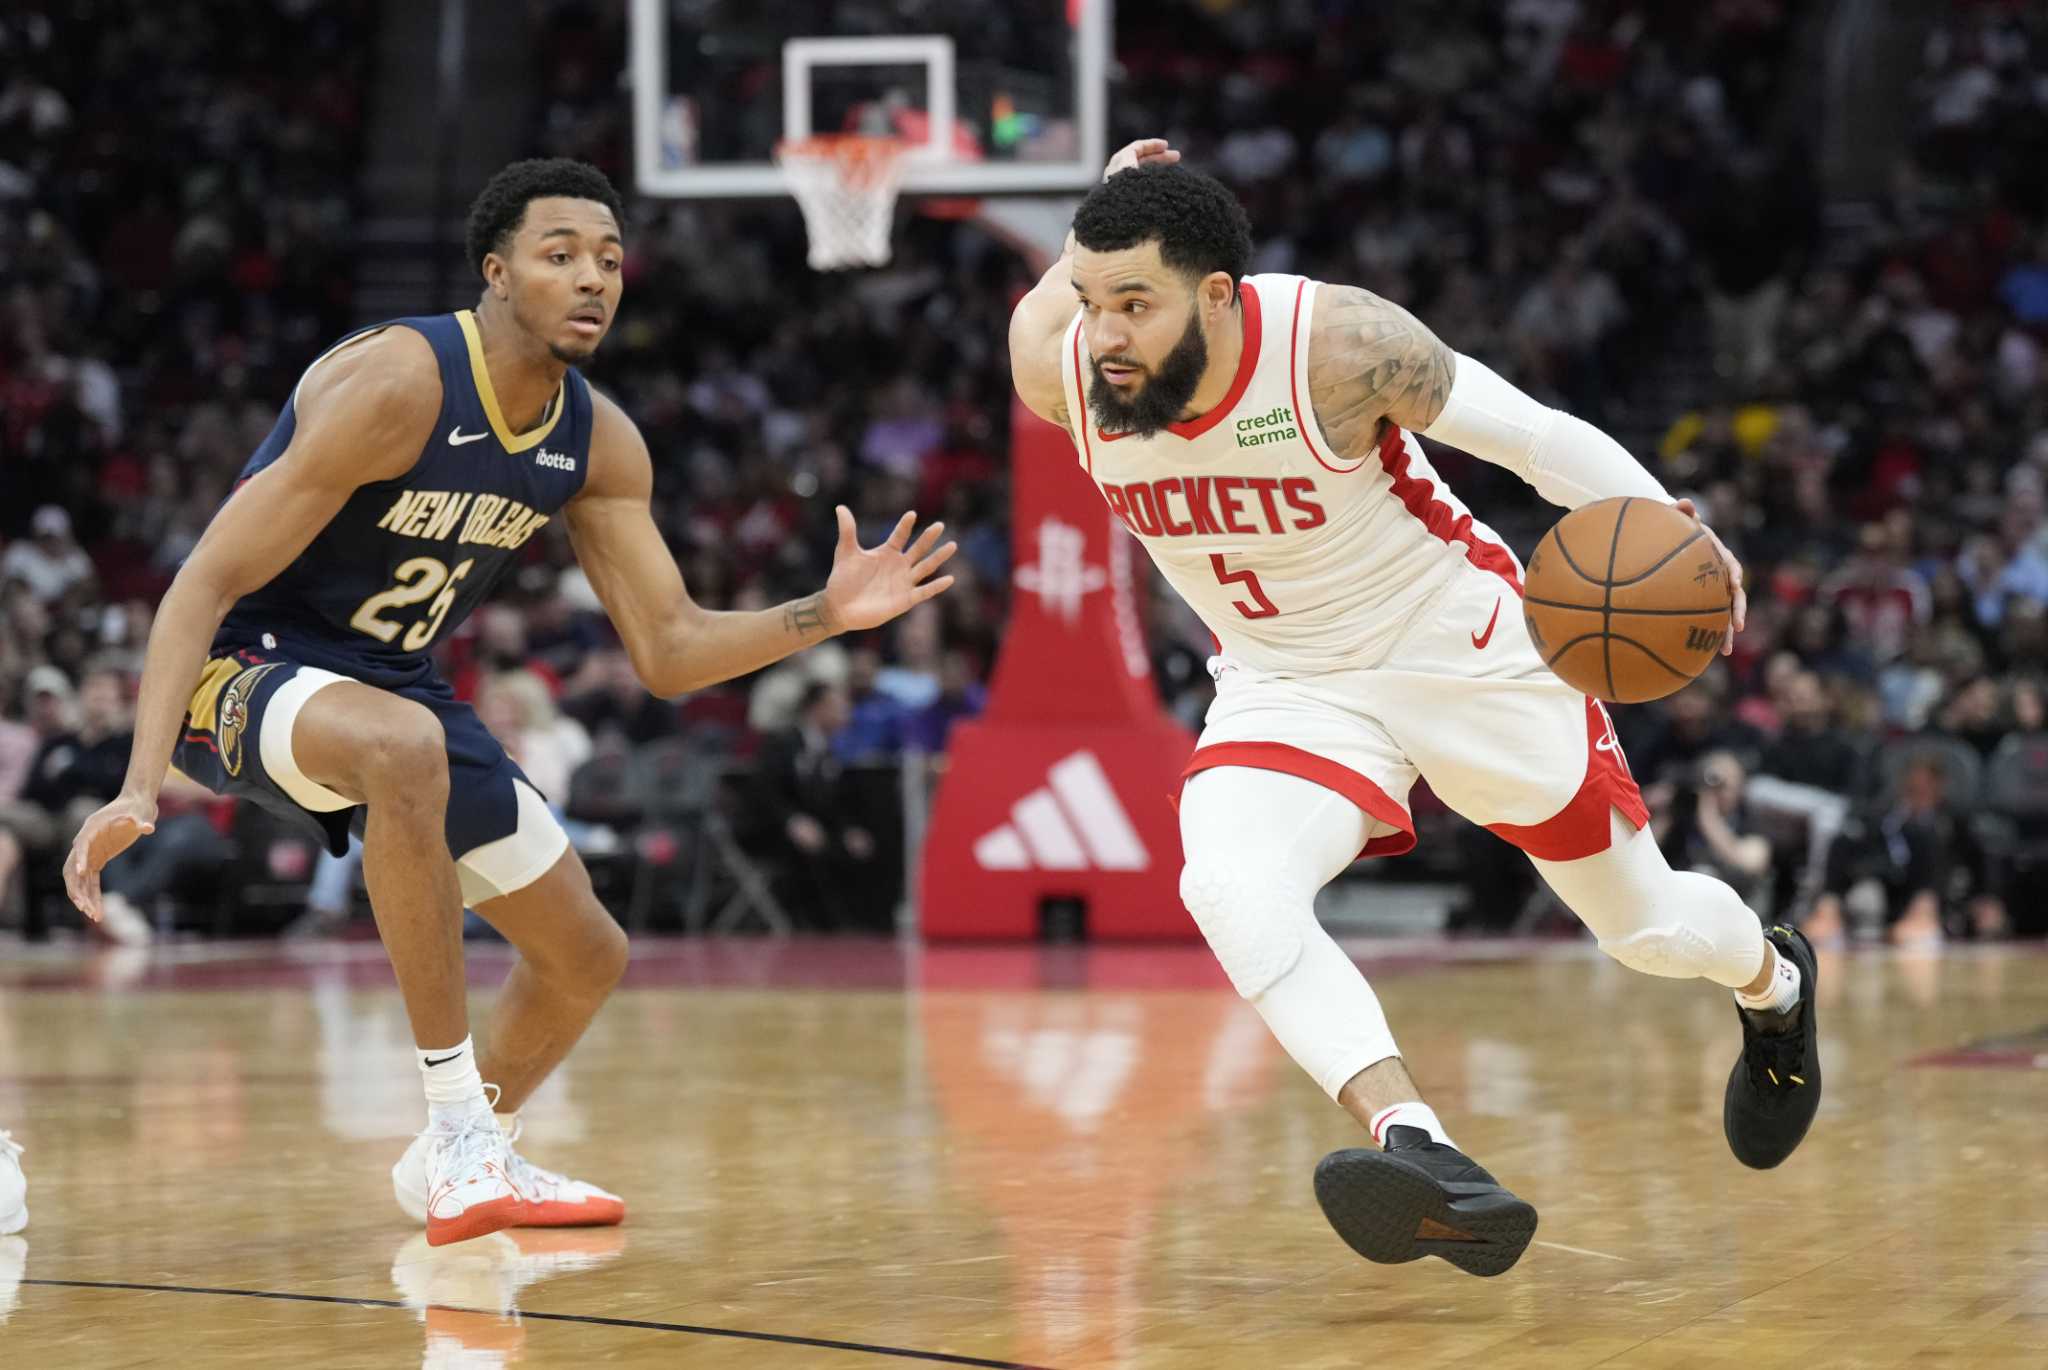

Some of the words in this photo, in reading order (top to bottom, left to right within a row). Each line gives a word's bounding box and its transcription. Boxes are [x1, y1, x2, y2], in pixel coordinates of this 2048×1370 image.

[1236, 408, 1293, 432] credit
[1236, 425, 1297, 448] karma
[536, 448, 576, 472] ibotta
[377, 490, 473, 541] NEW
[1101, 476, 1327, 537] ROCKETS
[1208, 552, 1280, 620] 5
